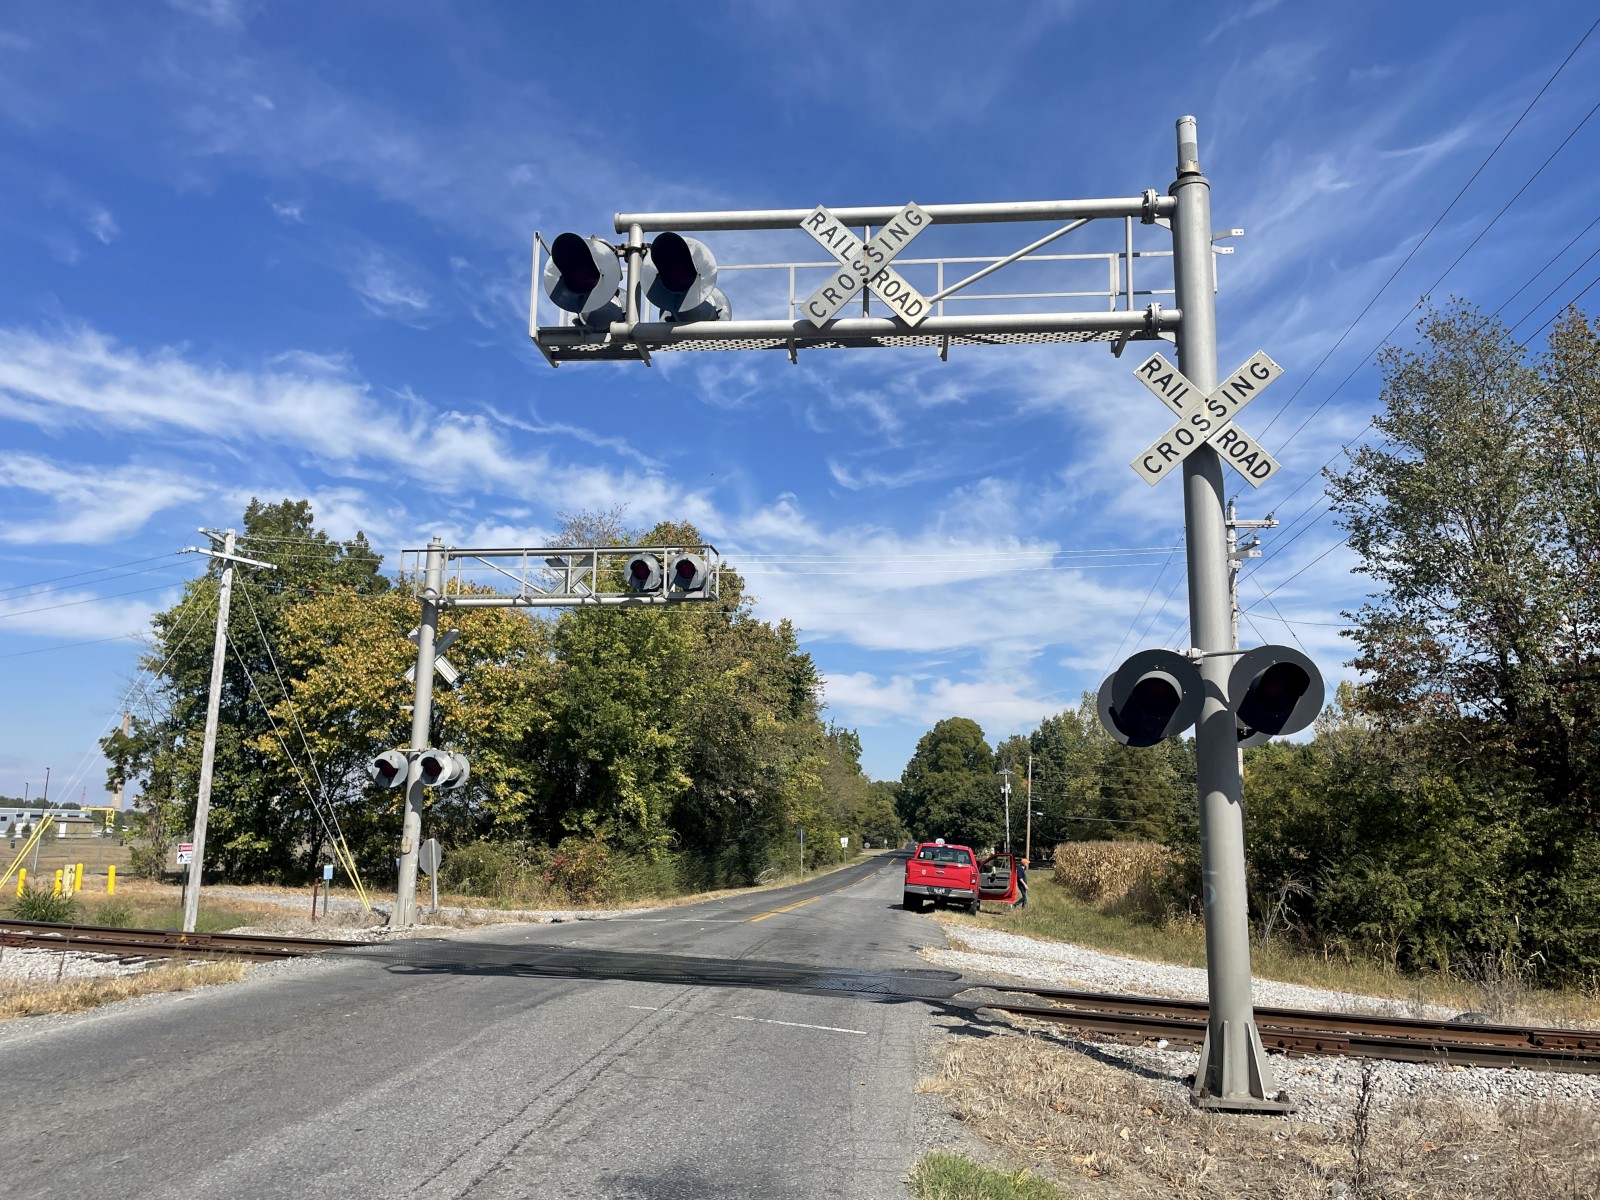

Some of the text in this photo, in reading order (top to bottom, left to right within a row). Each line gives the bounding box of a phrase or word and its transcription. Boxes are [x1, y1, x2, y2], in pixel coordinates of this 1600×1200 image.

[807, 211, 922, 317] RAIL ROAD
[809, 210, 922, 318] CROSSING
[1140, 358, 1271, 479] RAIL ROAD
[1143, 362, 1270, 474] CROSSING
